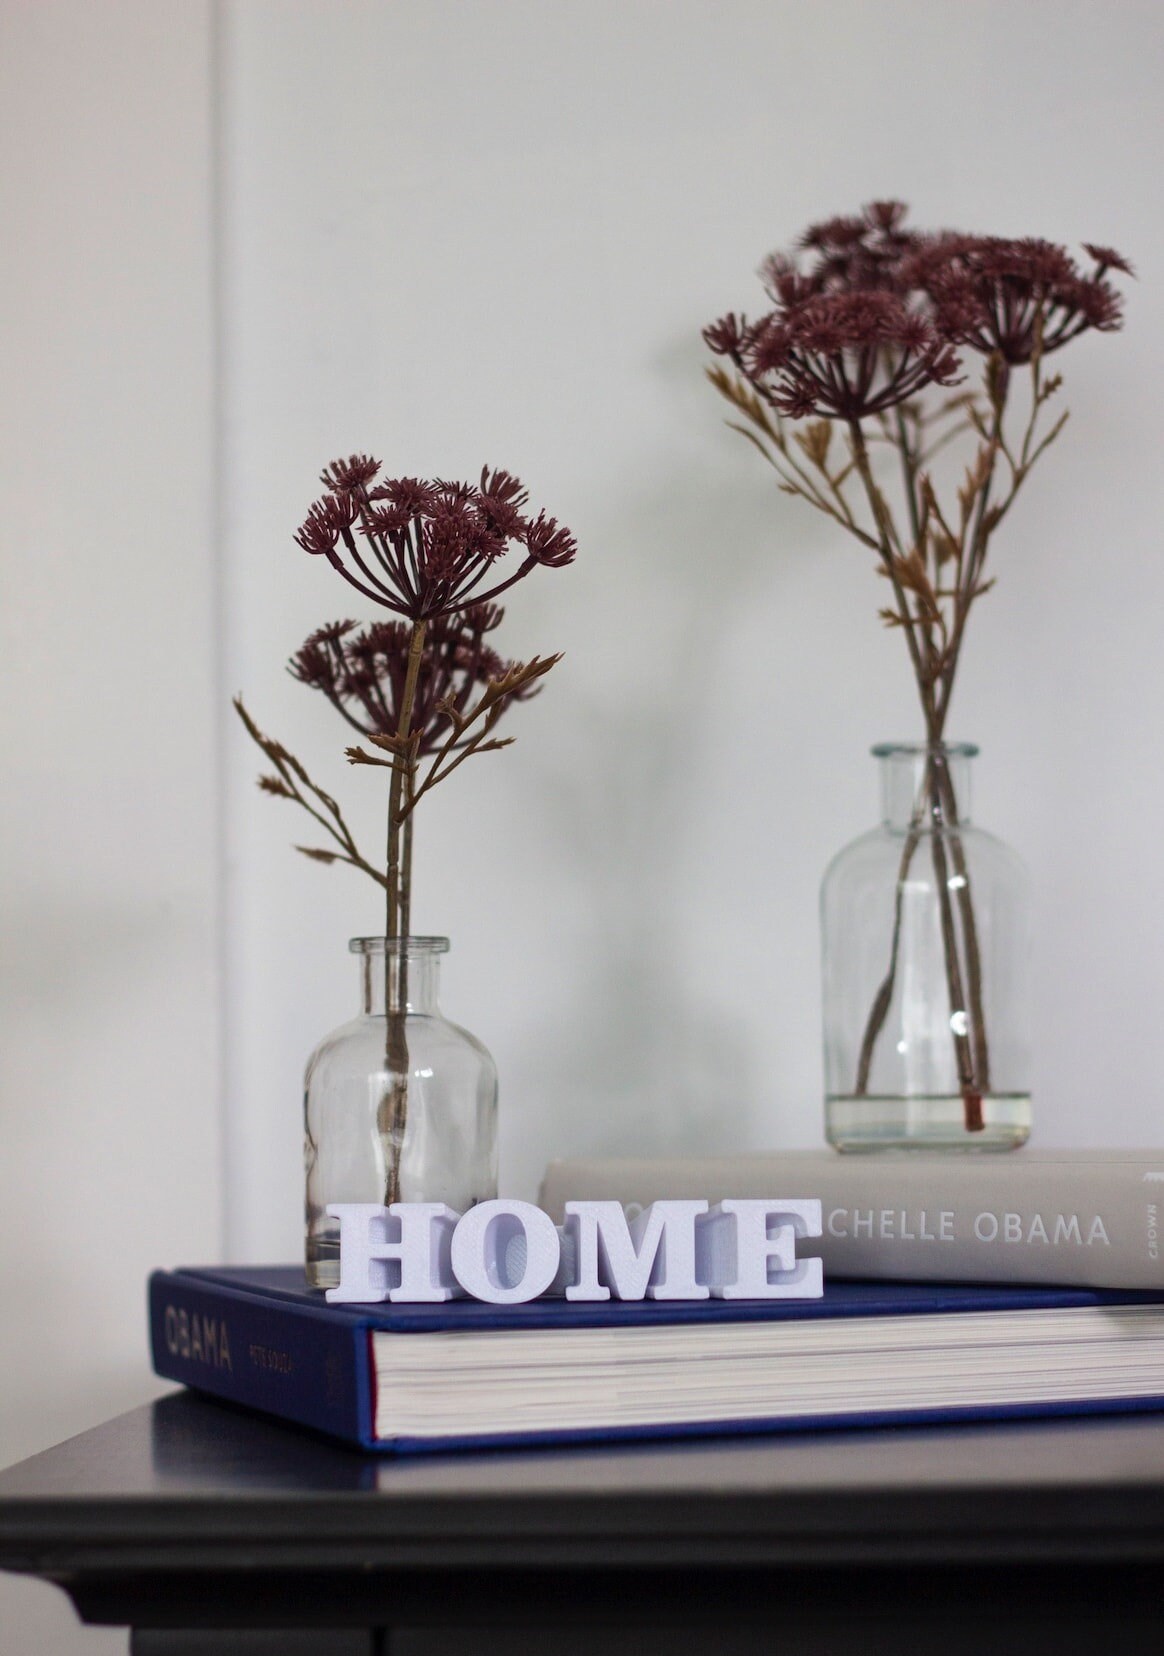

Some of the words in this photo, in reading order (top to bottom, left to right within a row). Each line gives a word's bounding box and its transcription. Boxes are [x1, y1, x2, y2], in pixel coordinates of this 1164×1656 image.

[325, 1198, 824, 1304] HOME
[827, 1208, 956, 1241] CHELLE
[973, 1211, 1112, 1246] OBAMA
[1146, 1203, 1159, 1259] CROWN
[164, 1303, 234, 1373] OBAMA
